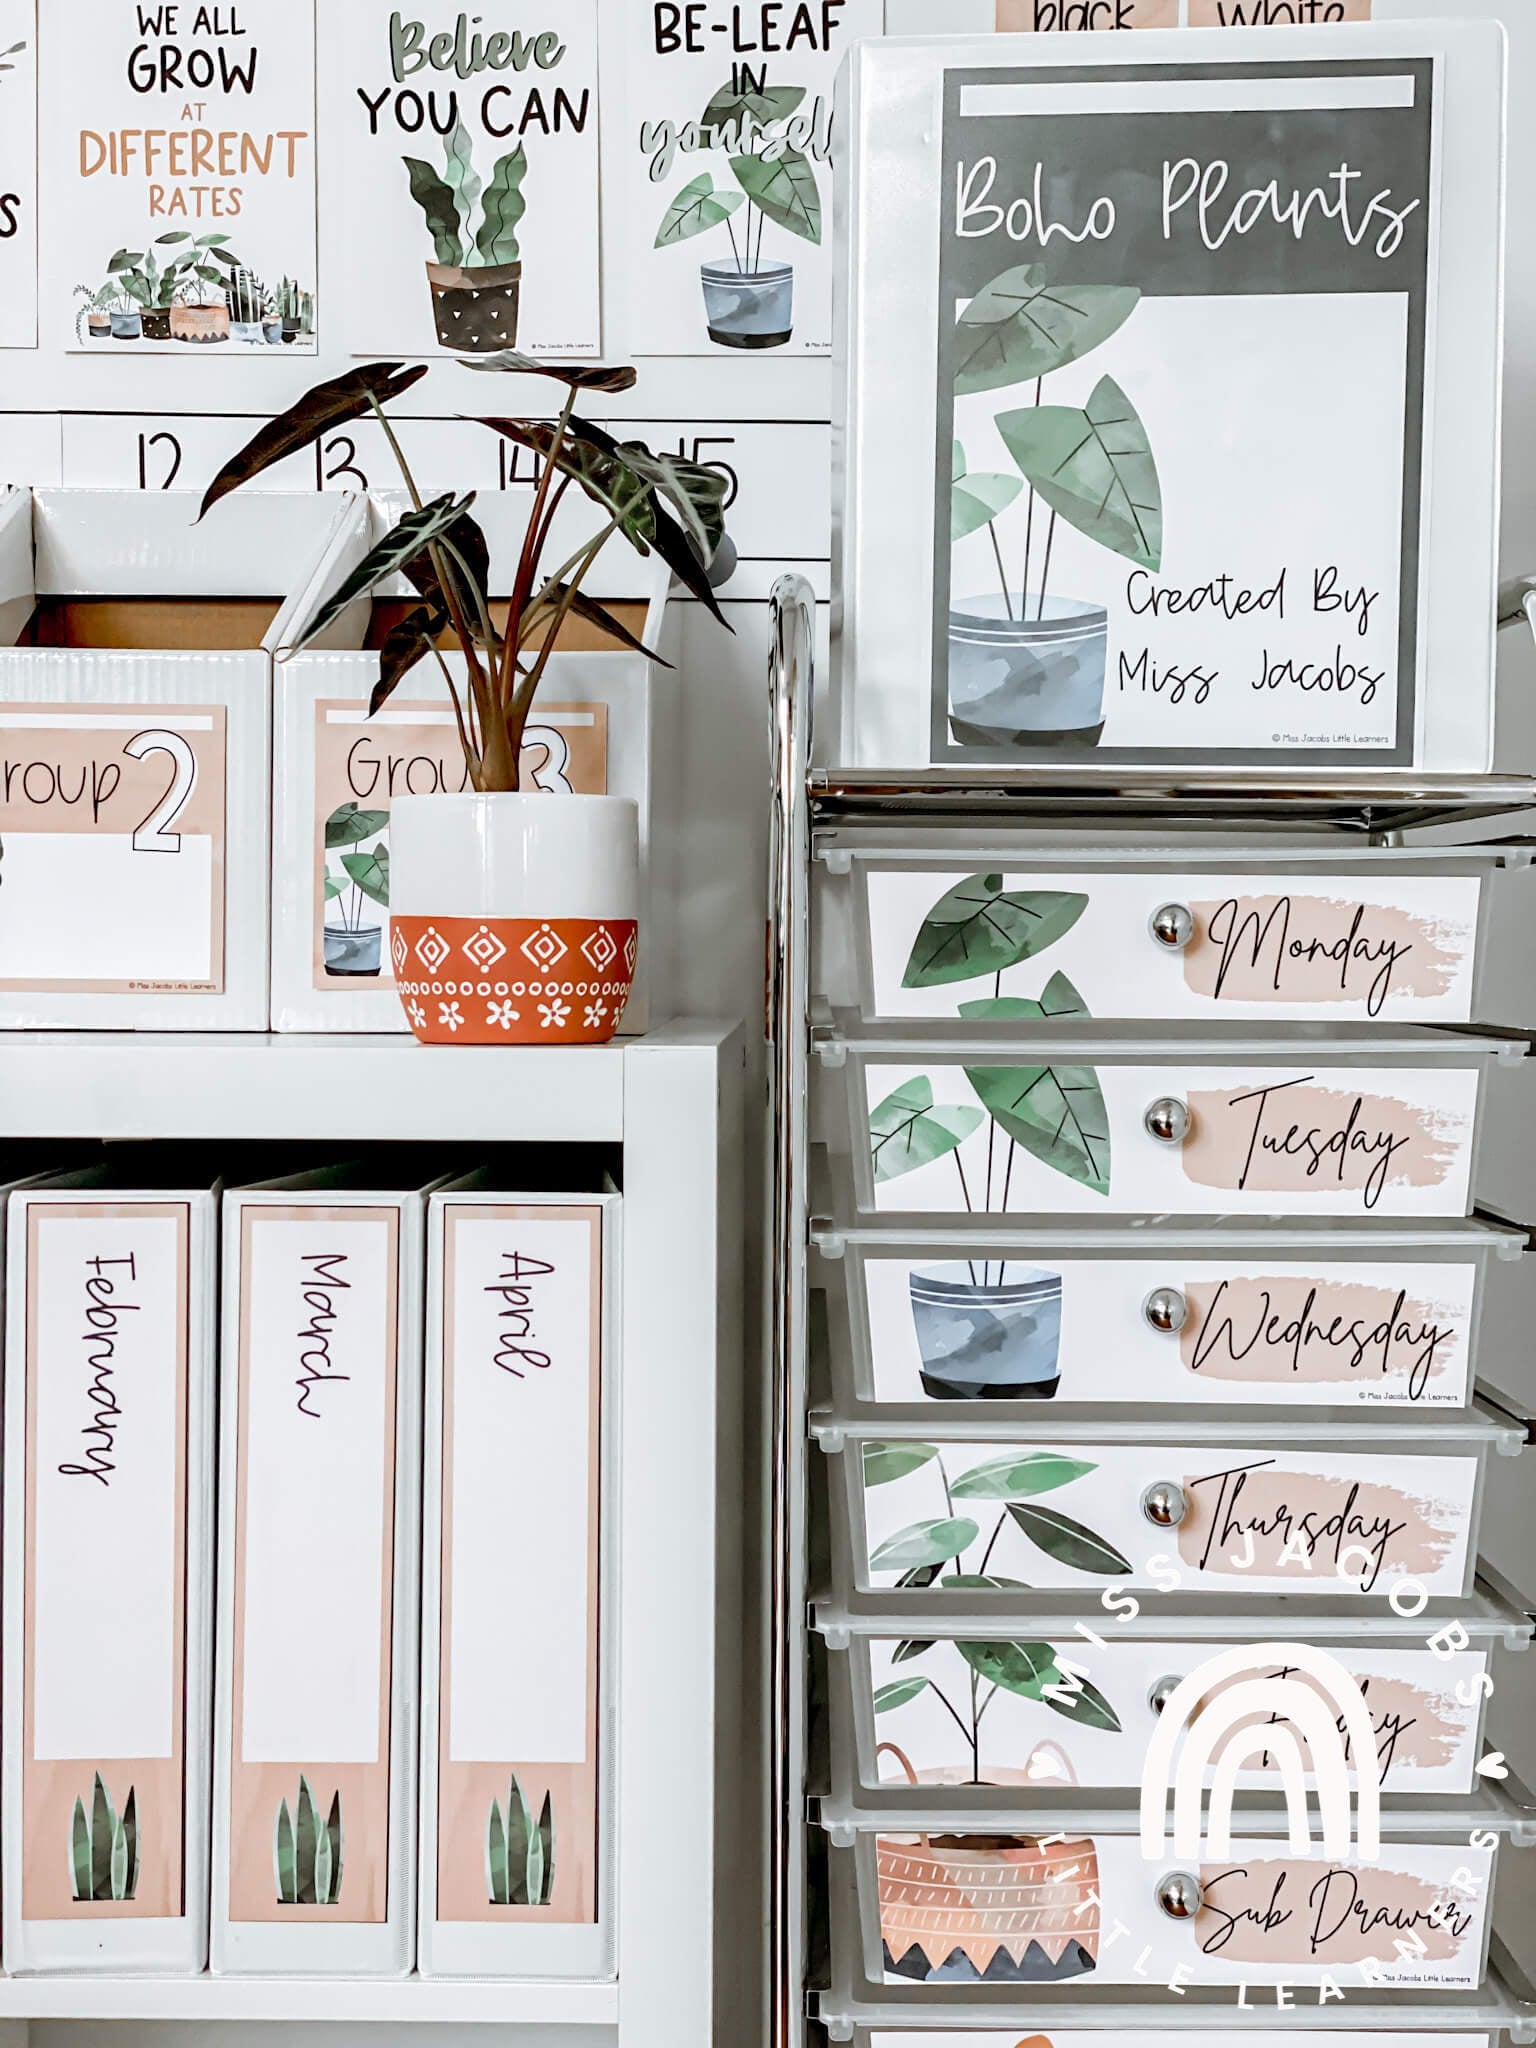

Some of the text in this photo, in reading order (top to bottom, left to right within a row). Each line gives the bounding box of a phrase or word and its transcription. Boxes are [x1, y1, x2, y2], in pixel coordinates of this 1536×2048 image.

[137, 5, 246, 36] WE ALL
[389, 12, 566, 83] Believe
[655, 0, 846, 54] BE-LEAF
[1034, 0, 1134, 31] black
[128, 44, 257, 94] GROW
[732, 62, 767, 96] IN
[181, 102, 207, 122] AT
[357, 87, 590, 135] YOU CAN
[79, 129, 308, 178] DIFFERENT
[149, 185, 242, 217] RATES
[956, 156, 1420, 258] Boho Plants
[139, 433, 181, 489] 12
[1127, 566, 1379, 636] Created By
[1119, 644, 1385, 705] Miss Jacobs
[4, 728, 195, 852] roup 2
[347, 737, 468, 797] Grou
[1208, 896, 1413, 1017] Monday
[1228, 1075, 1410, 1209] Tuesday
[295, 1254, 351, 1418] March
[484, 1251, 555, 1378] April
[1191, 1280, 1454, 1401] Wednesday
[58, 1251, 141, 1486] February
[1190, 1459, 1407, 1593] Thursday
[1201, 1869, 1293, 1954] Sub
